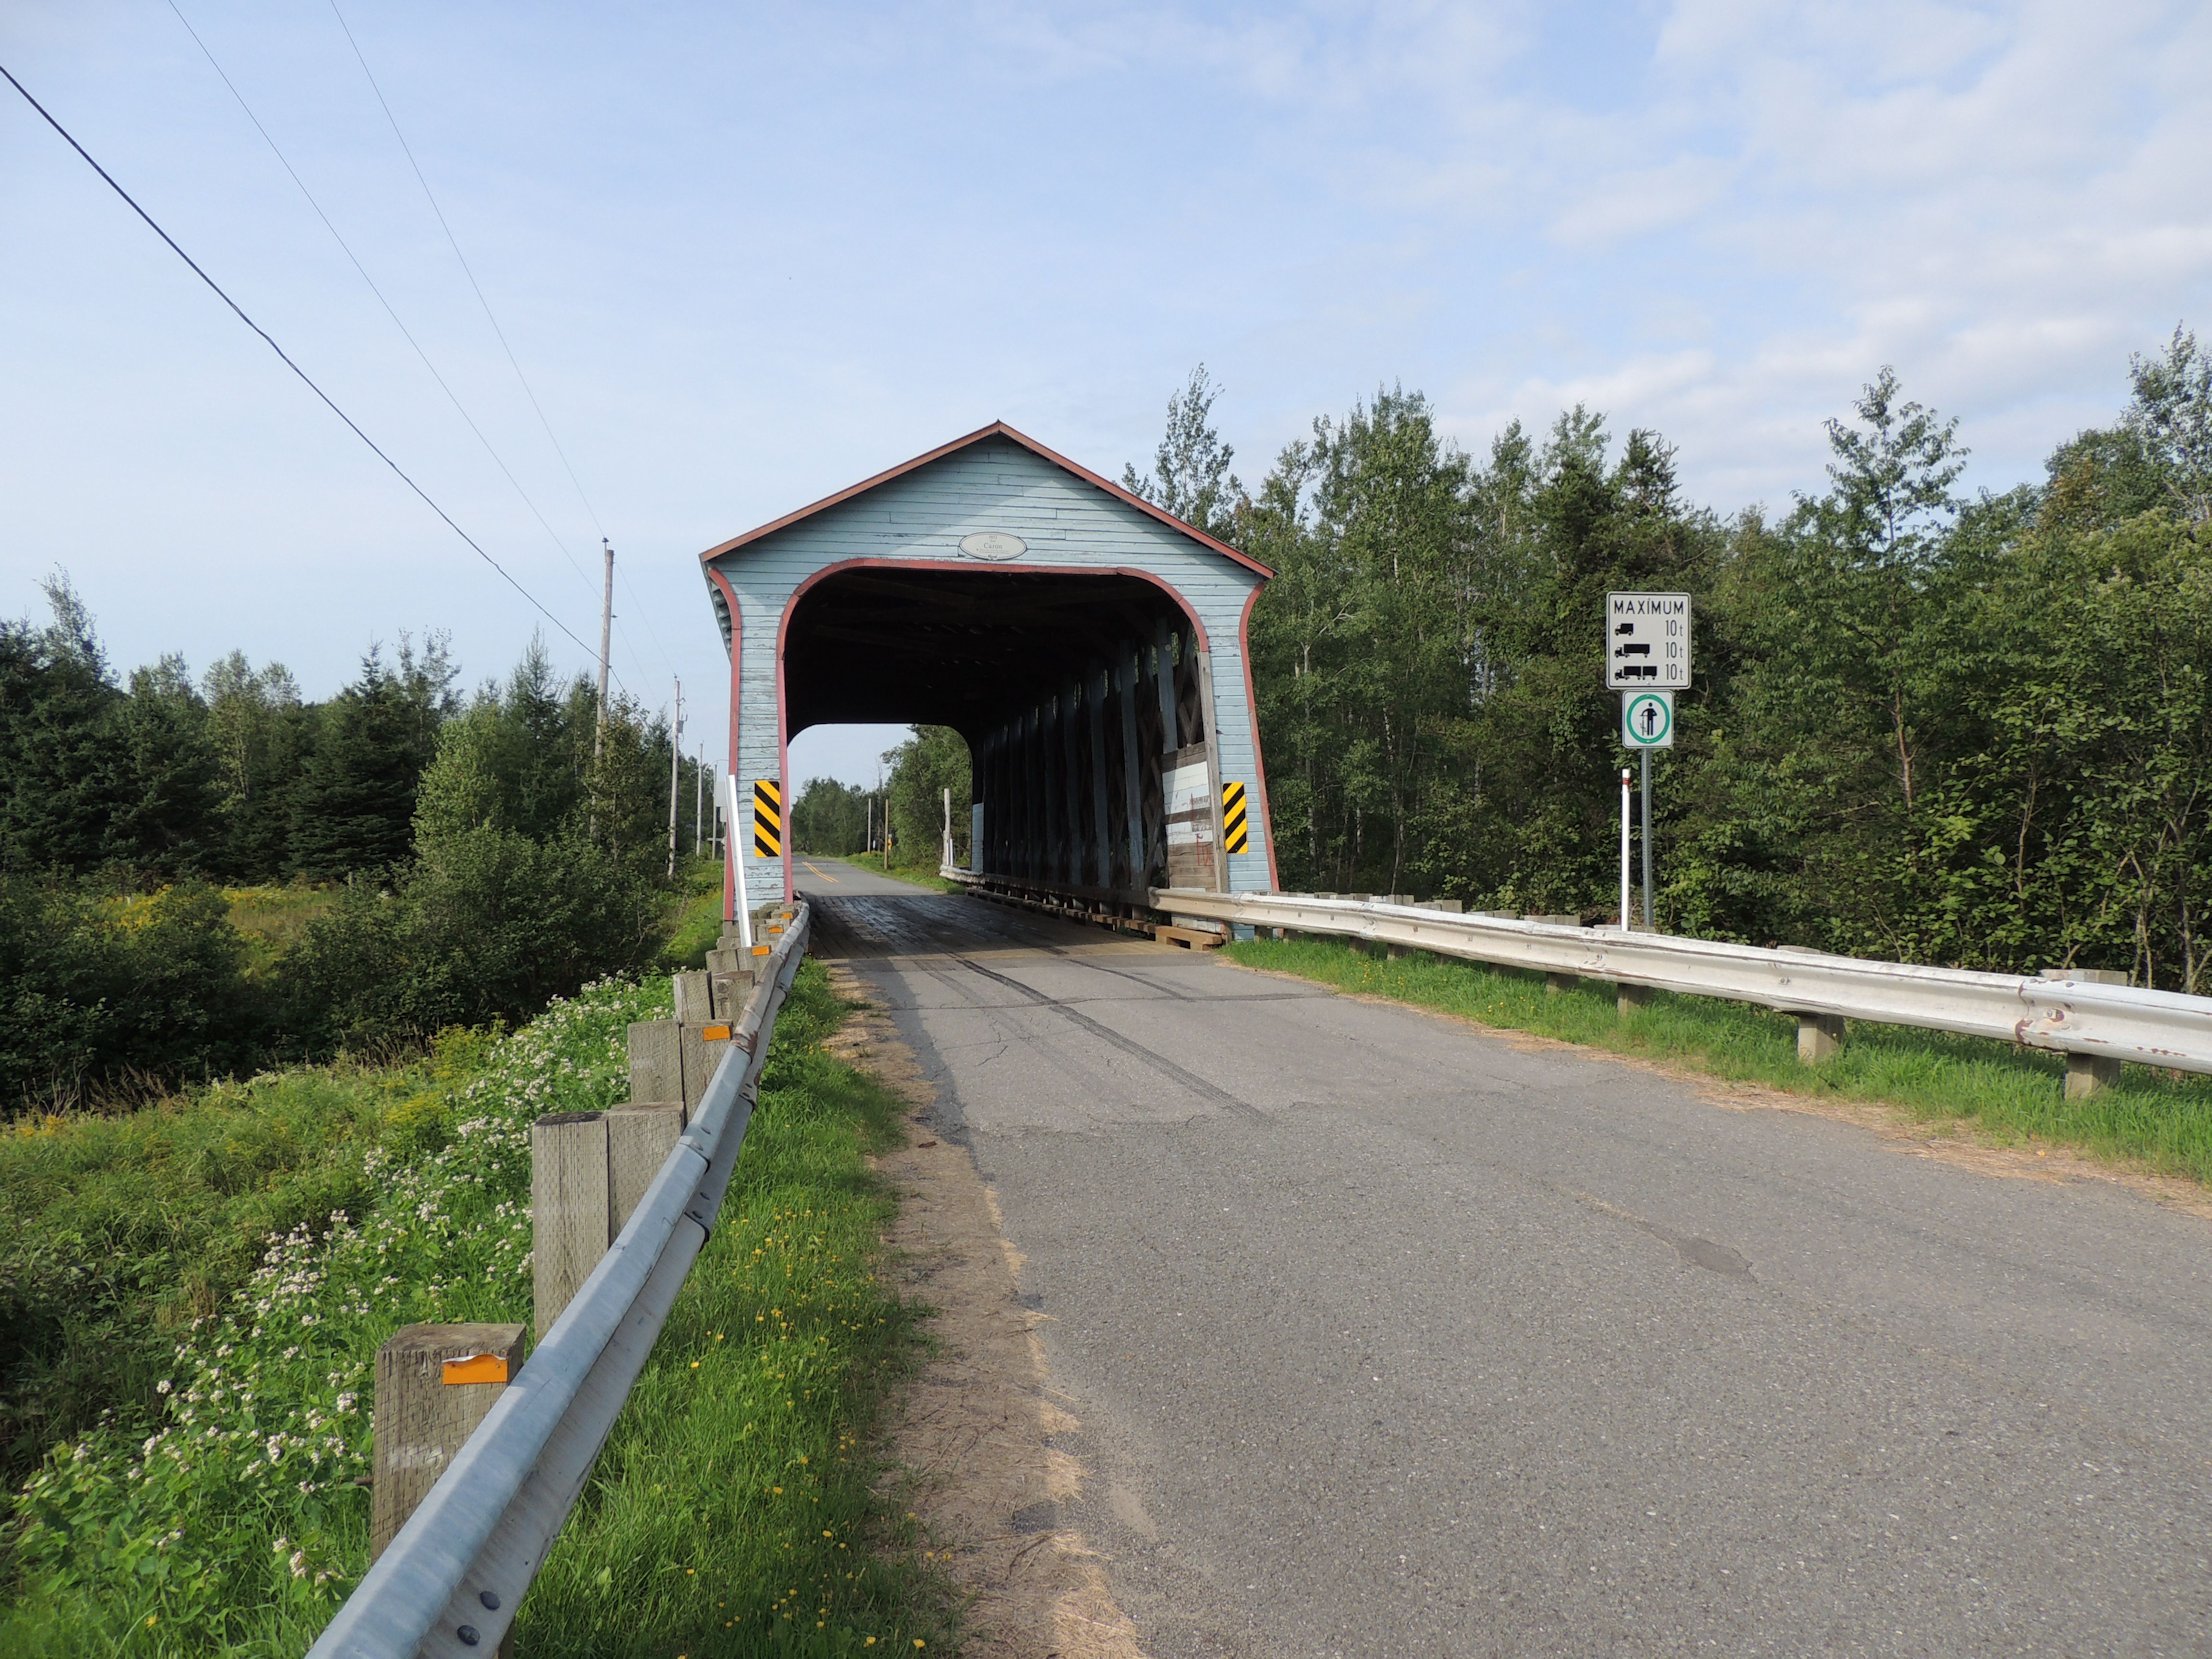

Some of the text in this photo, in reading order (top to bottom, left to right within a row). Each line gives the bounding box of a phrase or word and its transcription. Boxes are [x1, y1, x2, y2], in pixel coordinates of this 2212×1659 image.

[1614, 600, 1684, 615] MAXIMUM
[1665, 619, 1677, 637] 10
[1665, 641, 1677, 658] 10
[1665, 663, 1677, 680] 10
